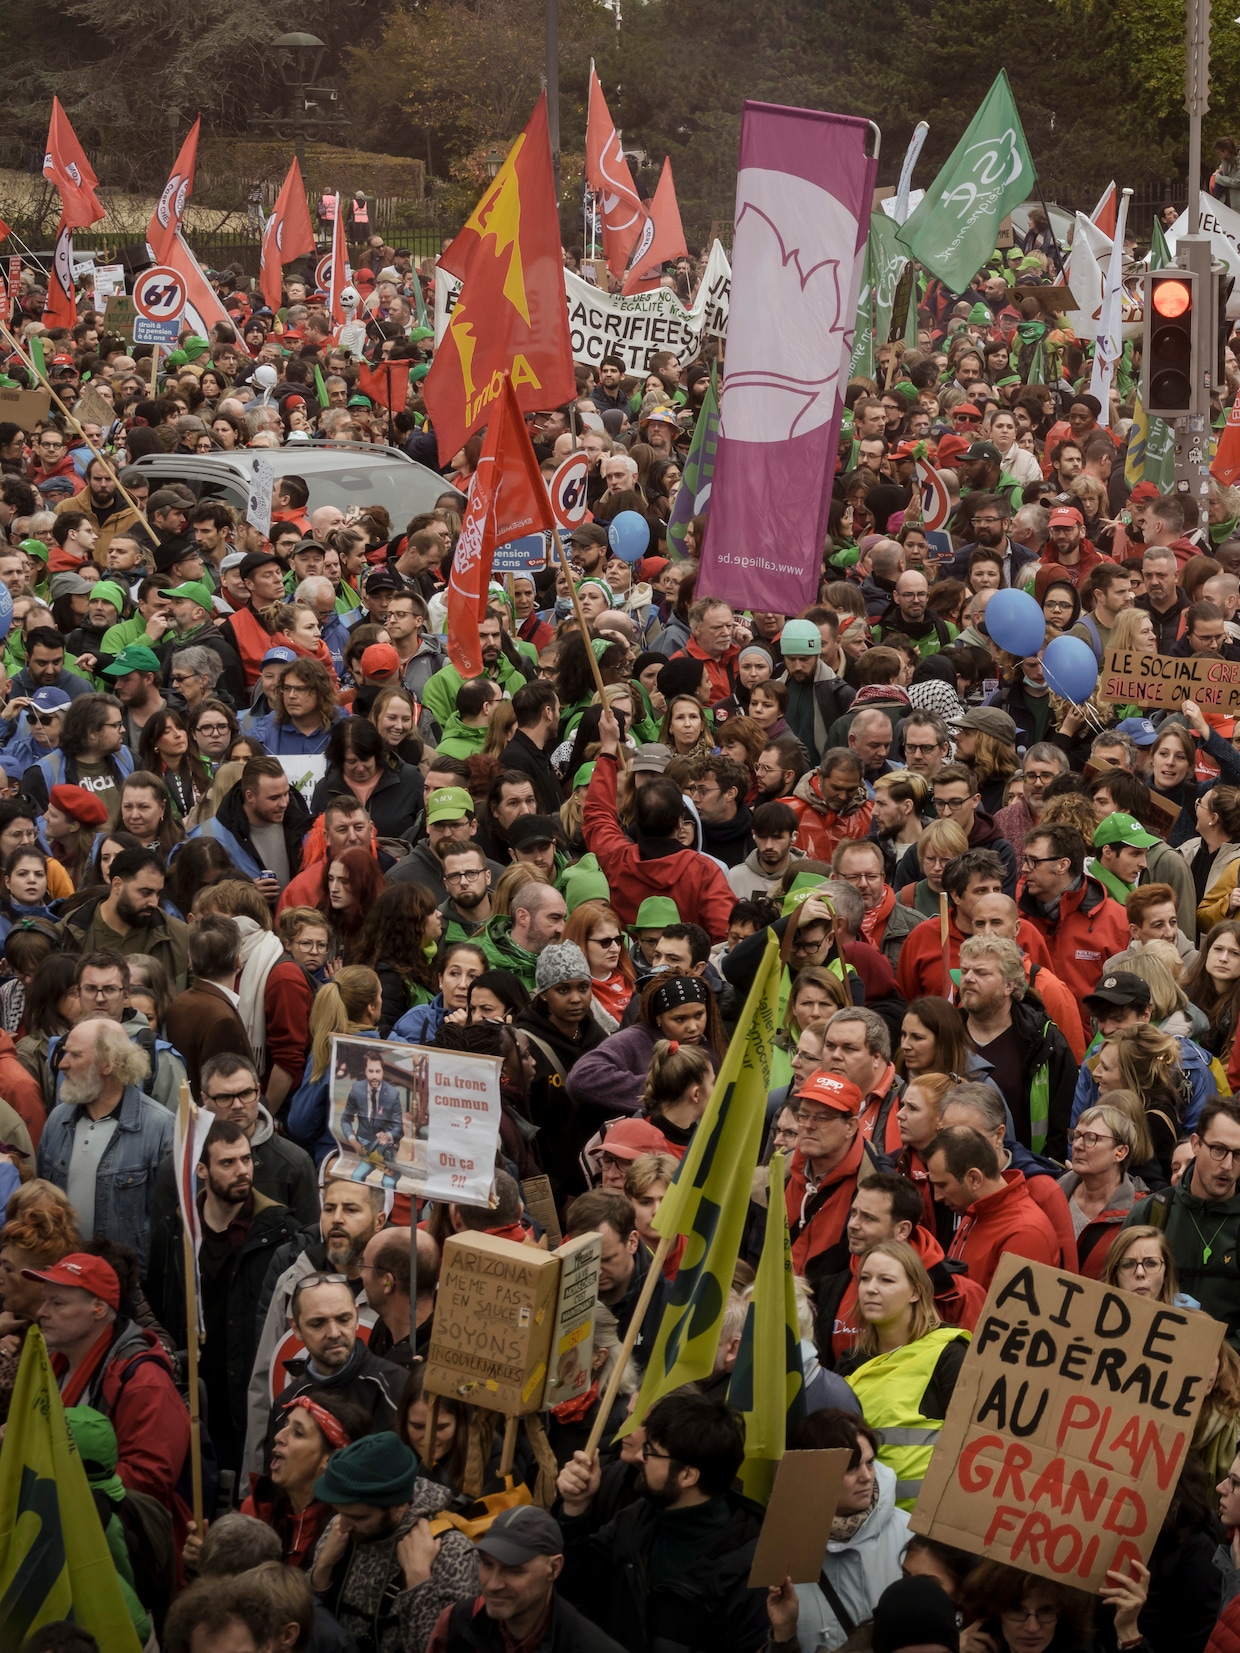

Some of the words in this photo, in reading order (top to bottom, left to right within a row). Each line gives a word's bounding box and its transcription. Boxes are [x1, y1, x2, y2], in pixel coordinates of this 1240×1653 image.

[144, 284, 178, 308] 67
[146, 328, 172, 336] pension
[570, 331, 661, 372] OCIÉTÉ
[562, 476, 587, 510] 67
[502, 558, 521, 568] ans
[1111, 652, 1132, 674] LE
[1140, 656, 1202, 681] SOCIAL
[1105, 678, 1164, 700] SILENCE
[1172, 685, 1190, 701] ON
[1194, 685, 1224, 704] CRIE
[434, 1072, 451, 1087] Un
[454, 1074, 486, 1092] tronc
[434, 1094, 489, 1112] commun
[464, 1116, 472, 1129] ?
[440, 1152, 456, 1168] Où
[459, 1159, 474, 1172] ça
[451, 1174, 466, 1188] ?!!
[450, 1250, 530, 1286] ARIZONA
[452, 1294, 470, 1308] EN
[476, 1300, 518, 1322] SAUCE
[496, 1286, 521, 1305] PAS
[996, 1266, 1188, 1364] AIDE
[436, 1318, 522, 1361] SOYONS
[432, 1346, 523, 1383] INGOUVERNABLES
[976, 1316, 1203, 1417] FÉDÉRALE
[977, 1374, 1049, 1436] AU
[1056, 1394, 1186, 1492] PLAN
[958, 1434, 1148, 1538] GRAND
[984, 1504, 1143, 1588] FROID
